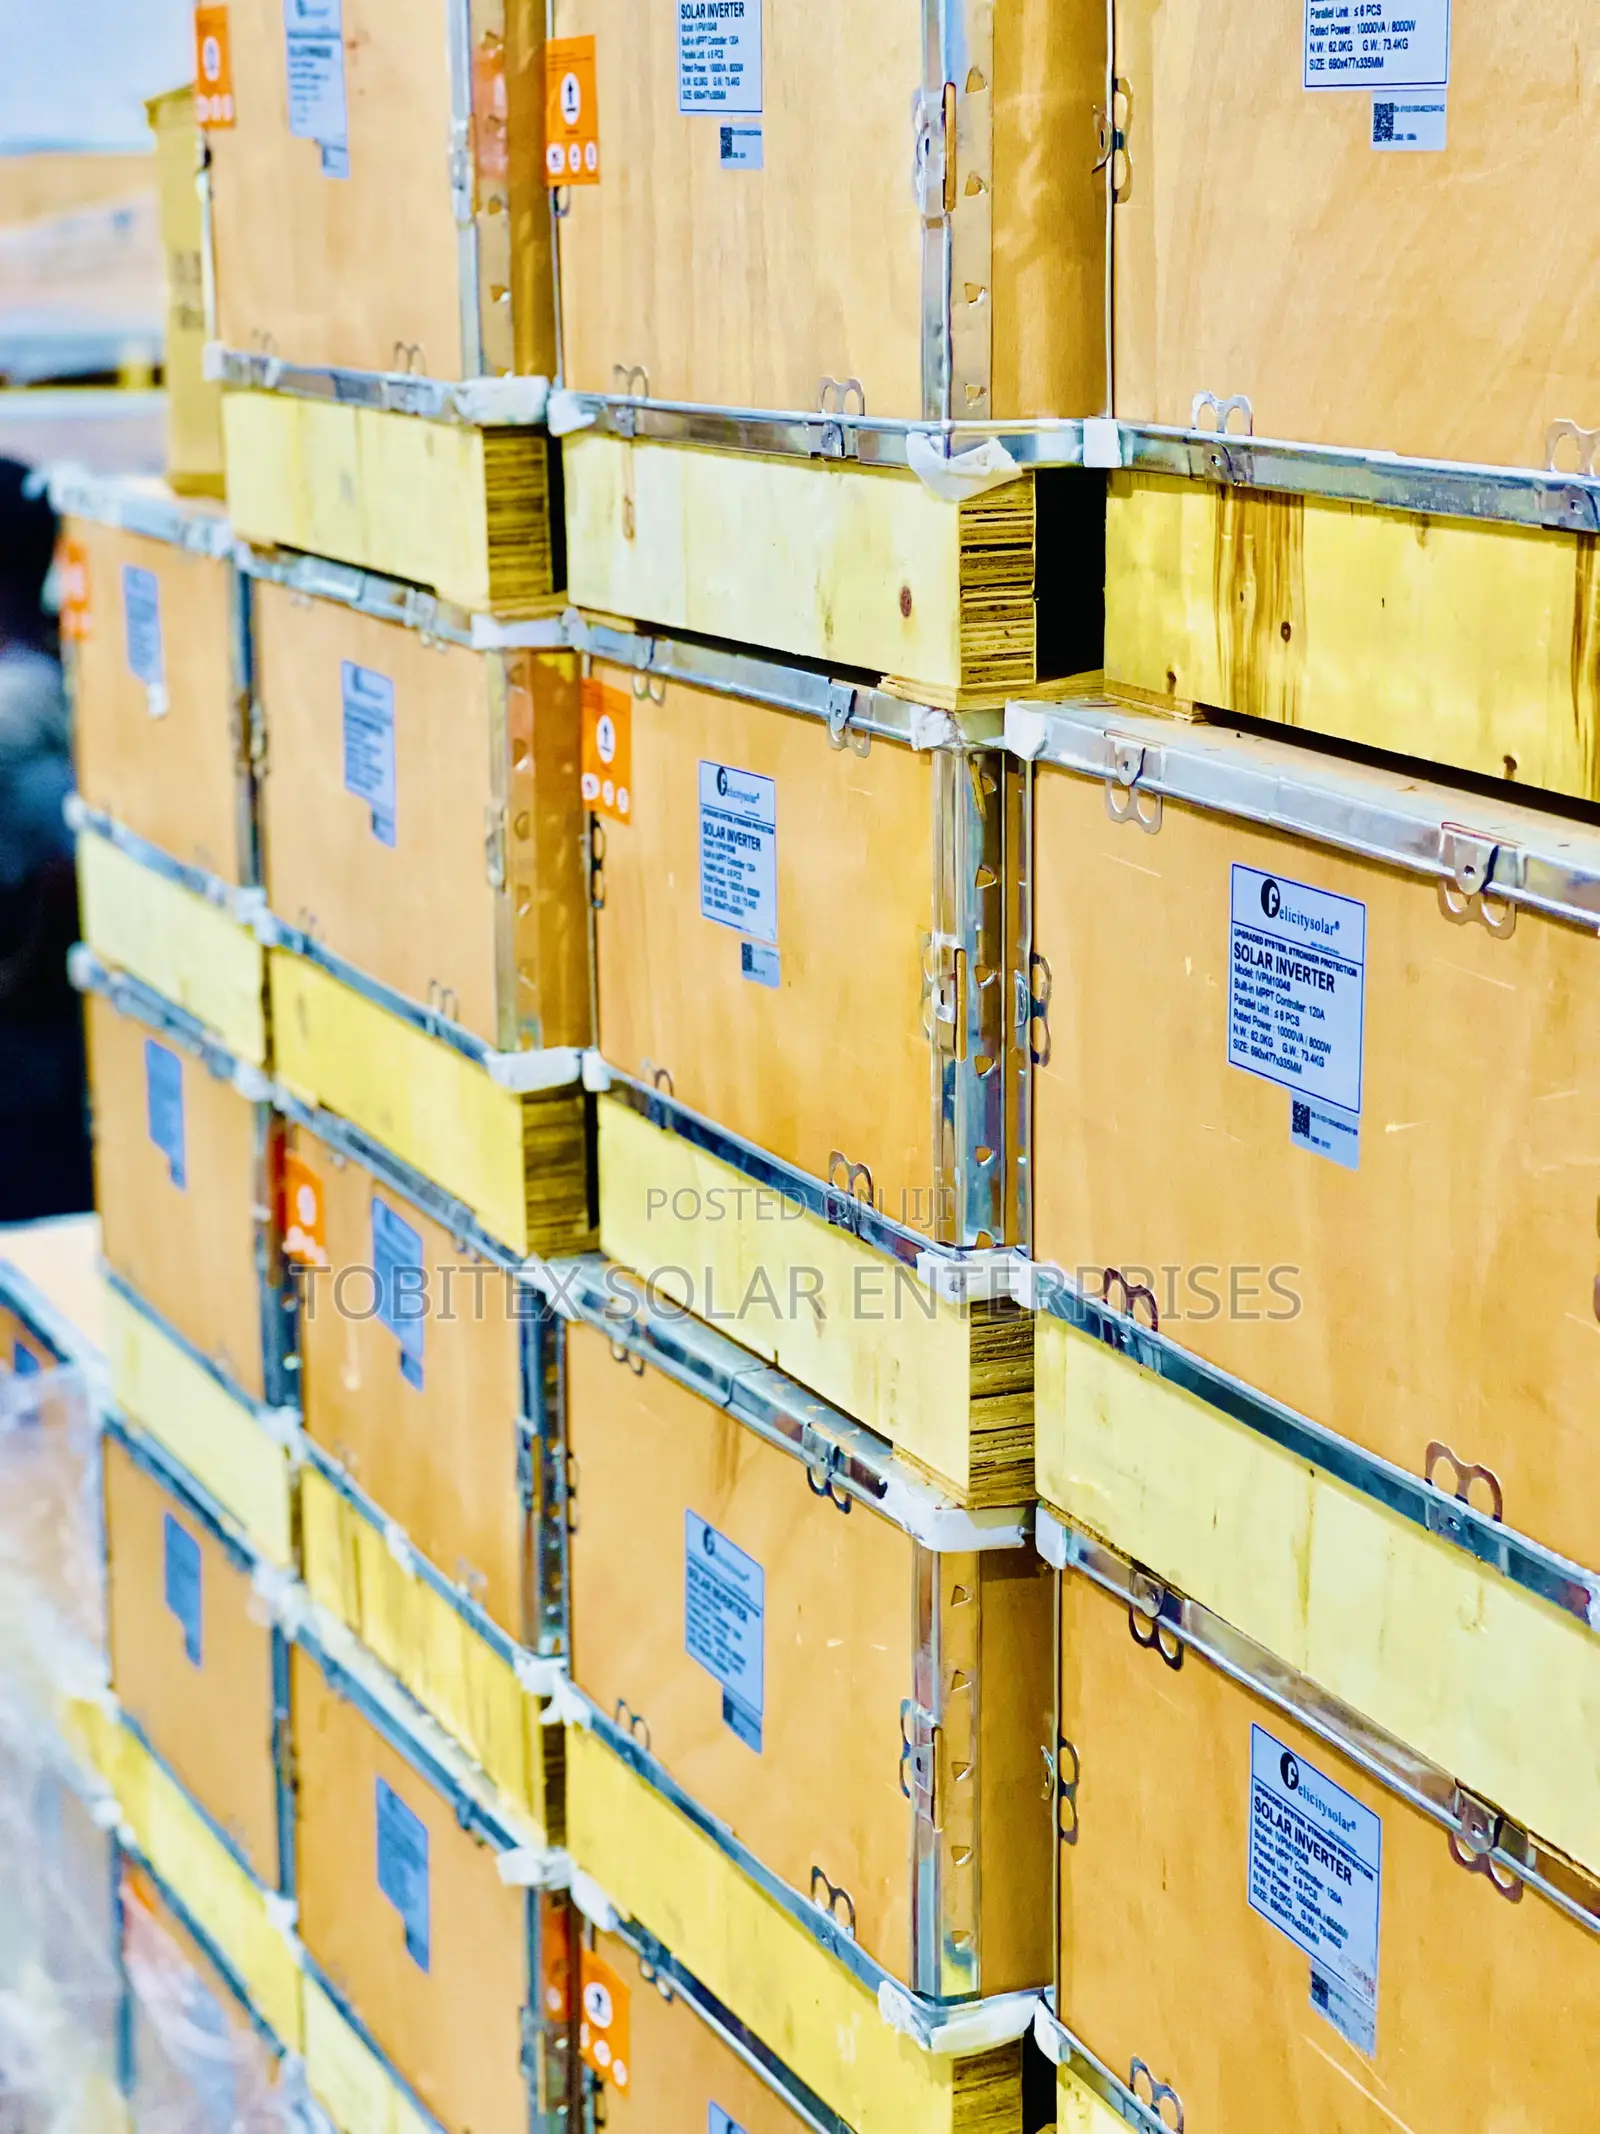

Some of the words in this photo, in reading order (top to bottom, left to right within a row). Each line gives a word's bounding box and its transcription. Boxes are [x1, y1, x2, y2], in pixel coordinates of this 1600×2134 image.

[681, 3, 706, 19] SOLAR
[708, 2, 745, 18] INVERTER
[1310, 7, 1334, 19] Parallel
[1366, 4, 1381, 16] PCS
[1310, 24, 1328, 36] Rated
[1357, 21, 1386, 34] 10000VA
[1328, 40, 1353, 52] 62.0KG
[1383, 38, 1408, 50] 73.4KG
[1328, 56, 1384, 70] 690x477x335MM
[703, 822, 725, 841] SOLAR
[727, 829, 761, 852] INVERTER
[1234, 928, 1263, 945] UPGRADED
[1289, 946, 1319, 965] STRONGER
[1320, 957, 1357, 977] PROTECTION
[1234, 942, 1273, 971] SOLAR
[1276, 956, 1335, 993] INVERTER
[1234, 993, 1256, 1010] Parallel
[1286, 1012, 1300, 1027] PCS
[1256, 986, 1274, 1001] MPPT
[1309, 1006, 1325, 1020] 120A
[1234, 1008, 1251, 1025] Rated
[1277, 1025, 1304, 1043] 10000VA
[1309, 1036, 1331, 1054] 8000W
[1250, 1030, 1273, 1048] 62.0KG
[1302, 1049, 1325, 1068] 73.4KG
[1250, 1046, 1302, 1074] 690x477x335MM
[1254, 1796, 1292, 1838] SOLAR
[1295, 1827, 1352, 1886] INVERTER
